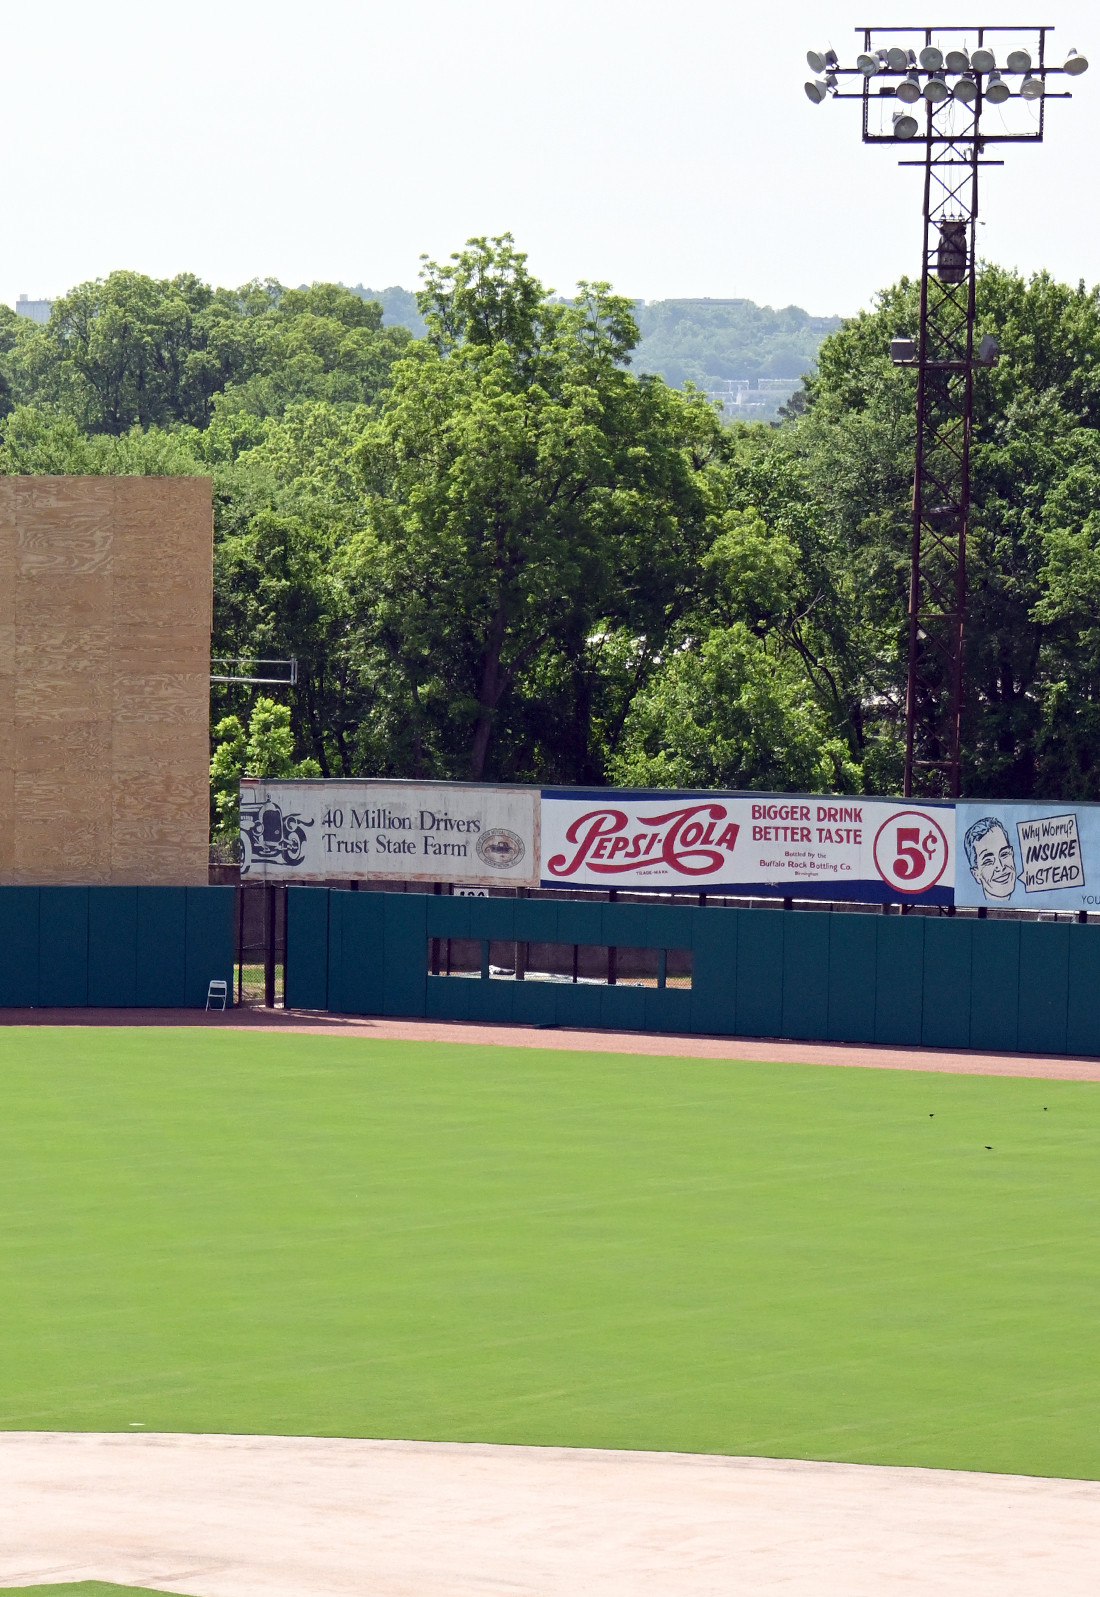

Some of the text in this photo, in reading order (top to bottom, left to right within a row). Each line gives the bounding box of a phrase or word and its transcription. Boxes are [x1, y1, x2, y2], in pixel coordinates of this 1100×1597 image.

[321, 808, 481, 833] 40 Million Drivers
[751, 804, 863, 823] BIGGER DRINK
[752, 825, 862, 845] BETTER TASTE
[1021, 819, 1074, 842] Why Worry?
[321, 833, 370, 854] Trust
[376, 834, 417, 855] State
[892, 827, 938, 880] 5¢
[1025, 839, 1077, 864] INSURE
[810, 862, 838, 872] Bottling
[1025, 865, 1080, 887] inSTEAD
